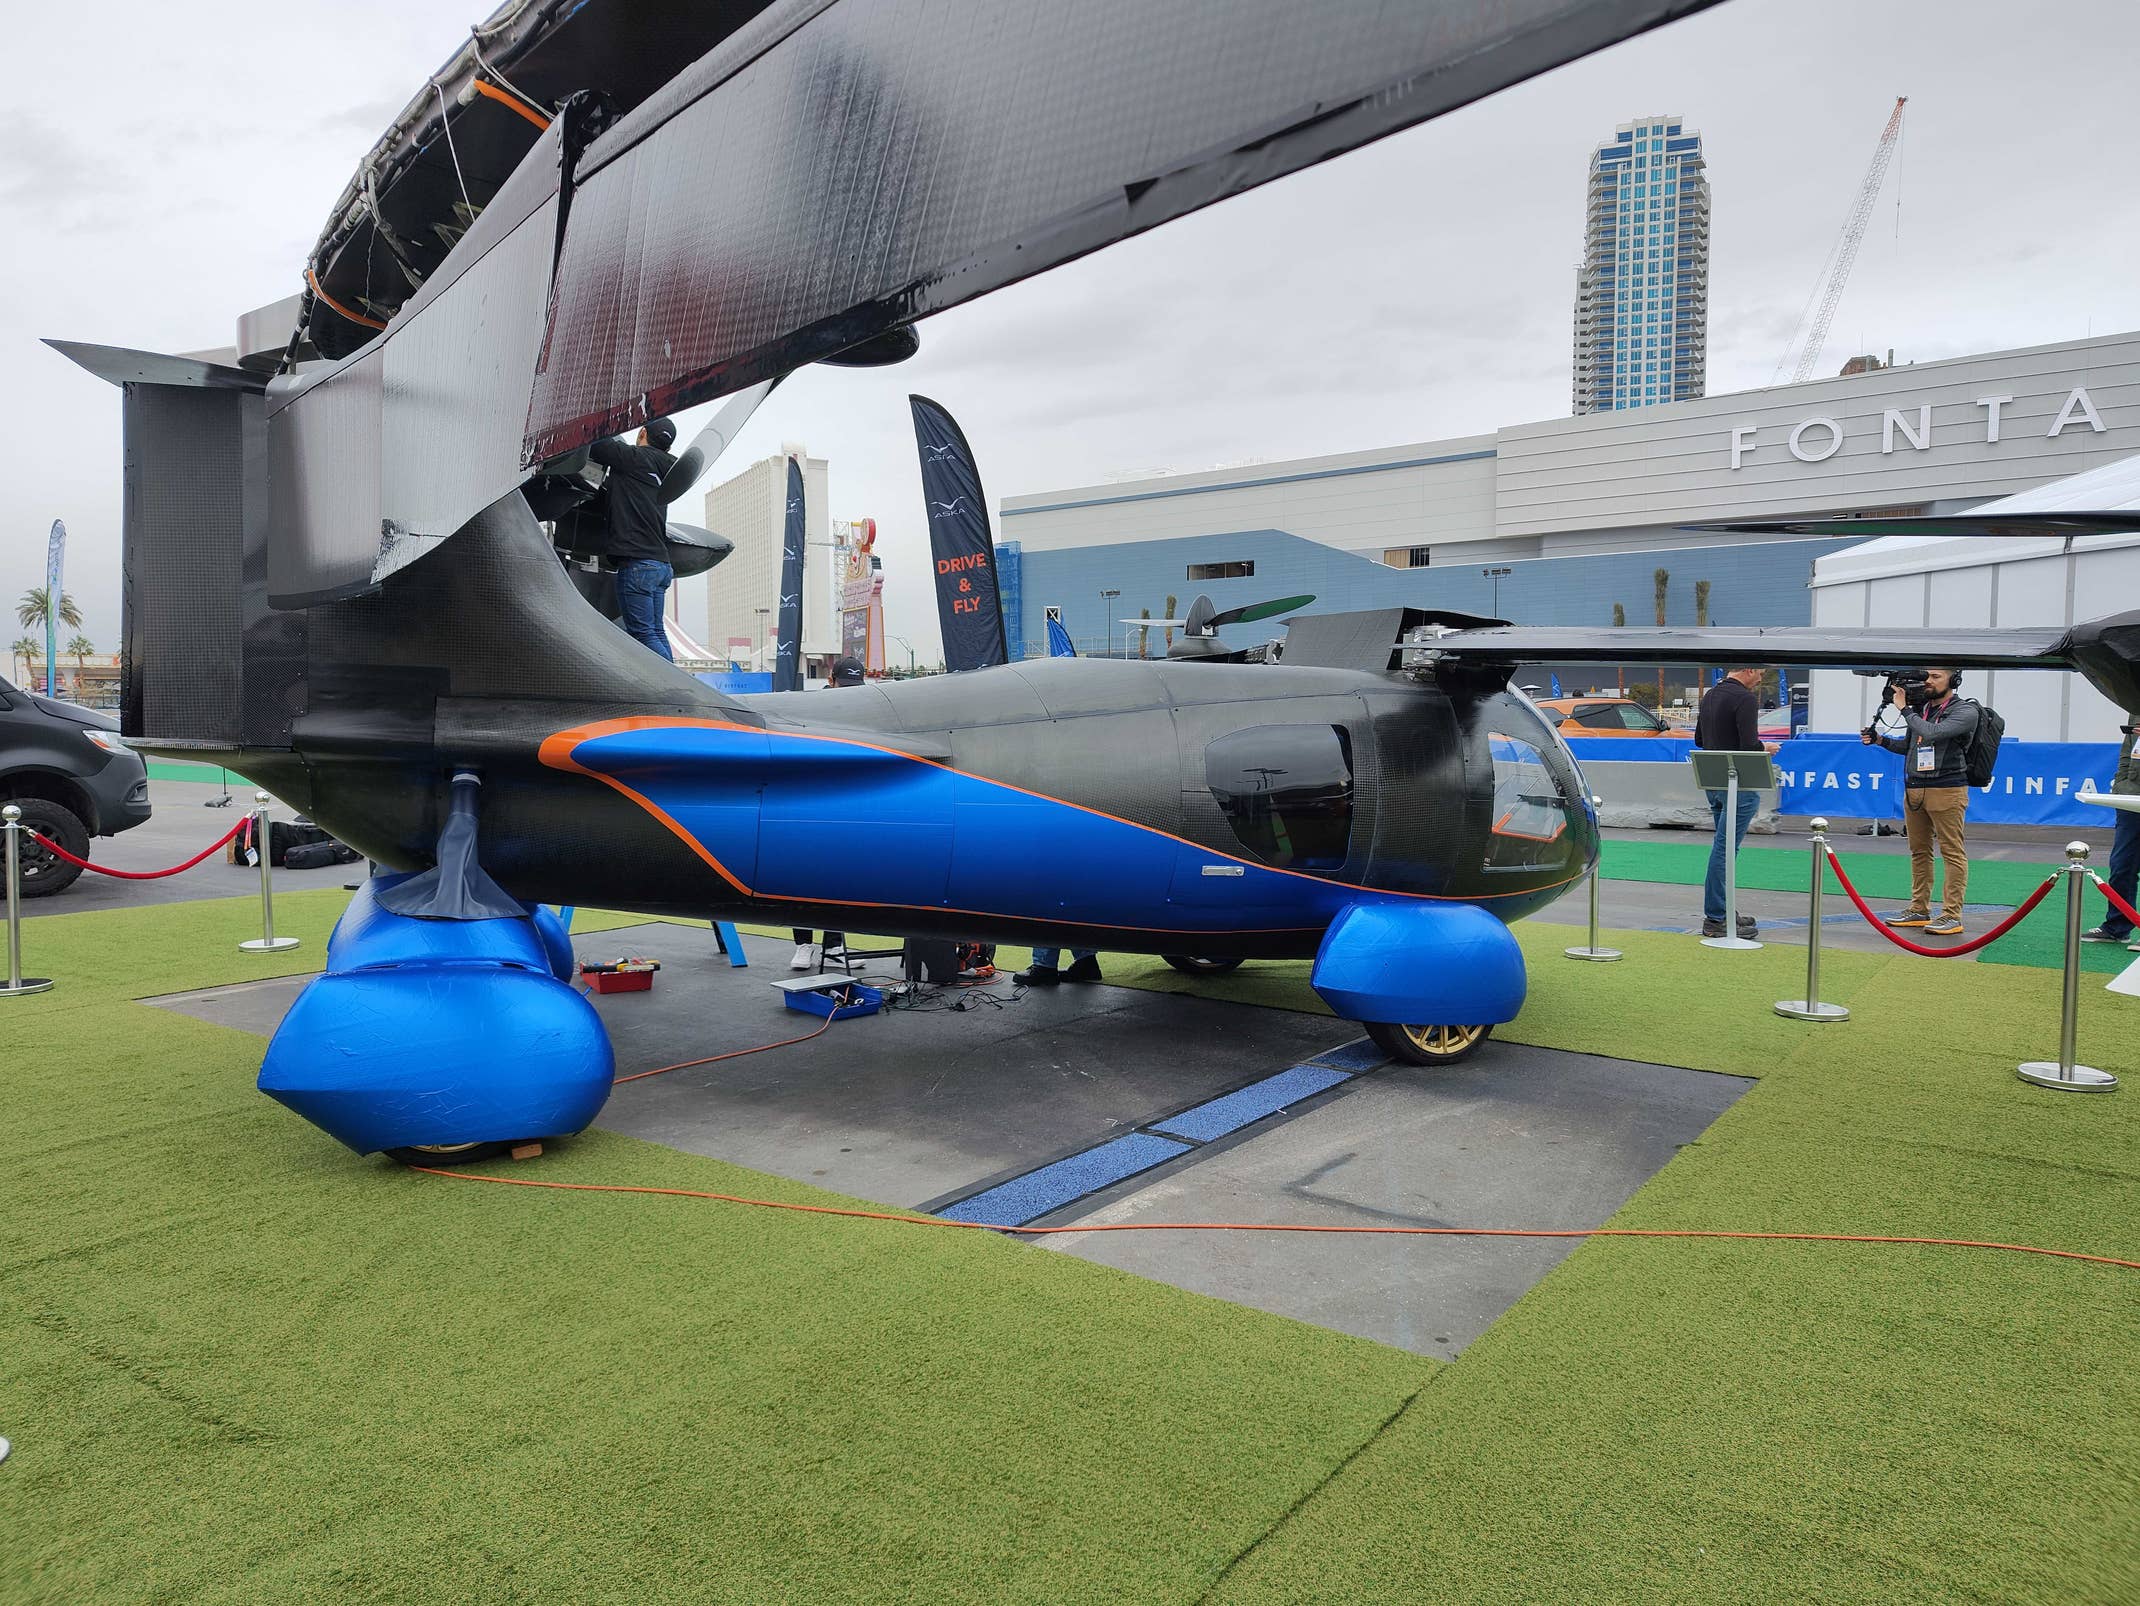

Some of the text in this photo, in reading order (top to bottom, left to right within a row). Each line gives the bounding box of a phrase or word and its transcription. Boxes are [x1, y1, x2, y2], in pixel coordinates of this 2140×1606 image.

[1730, 386, 2106, 470] FONTA
[934, 508, 966, 519] ASKA
[937, 552, 986, 575] DRIVE
[959, 578, 972, 592] &
[953, 596, 981, 614] FLY
[1981, 776, 2116, 795] VINFA
